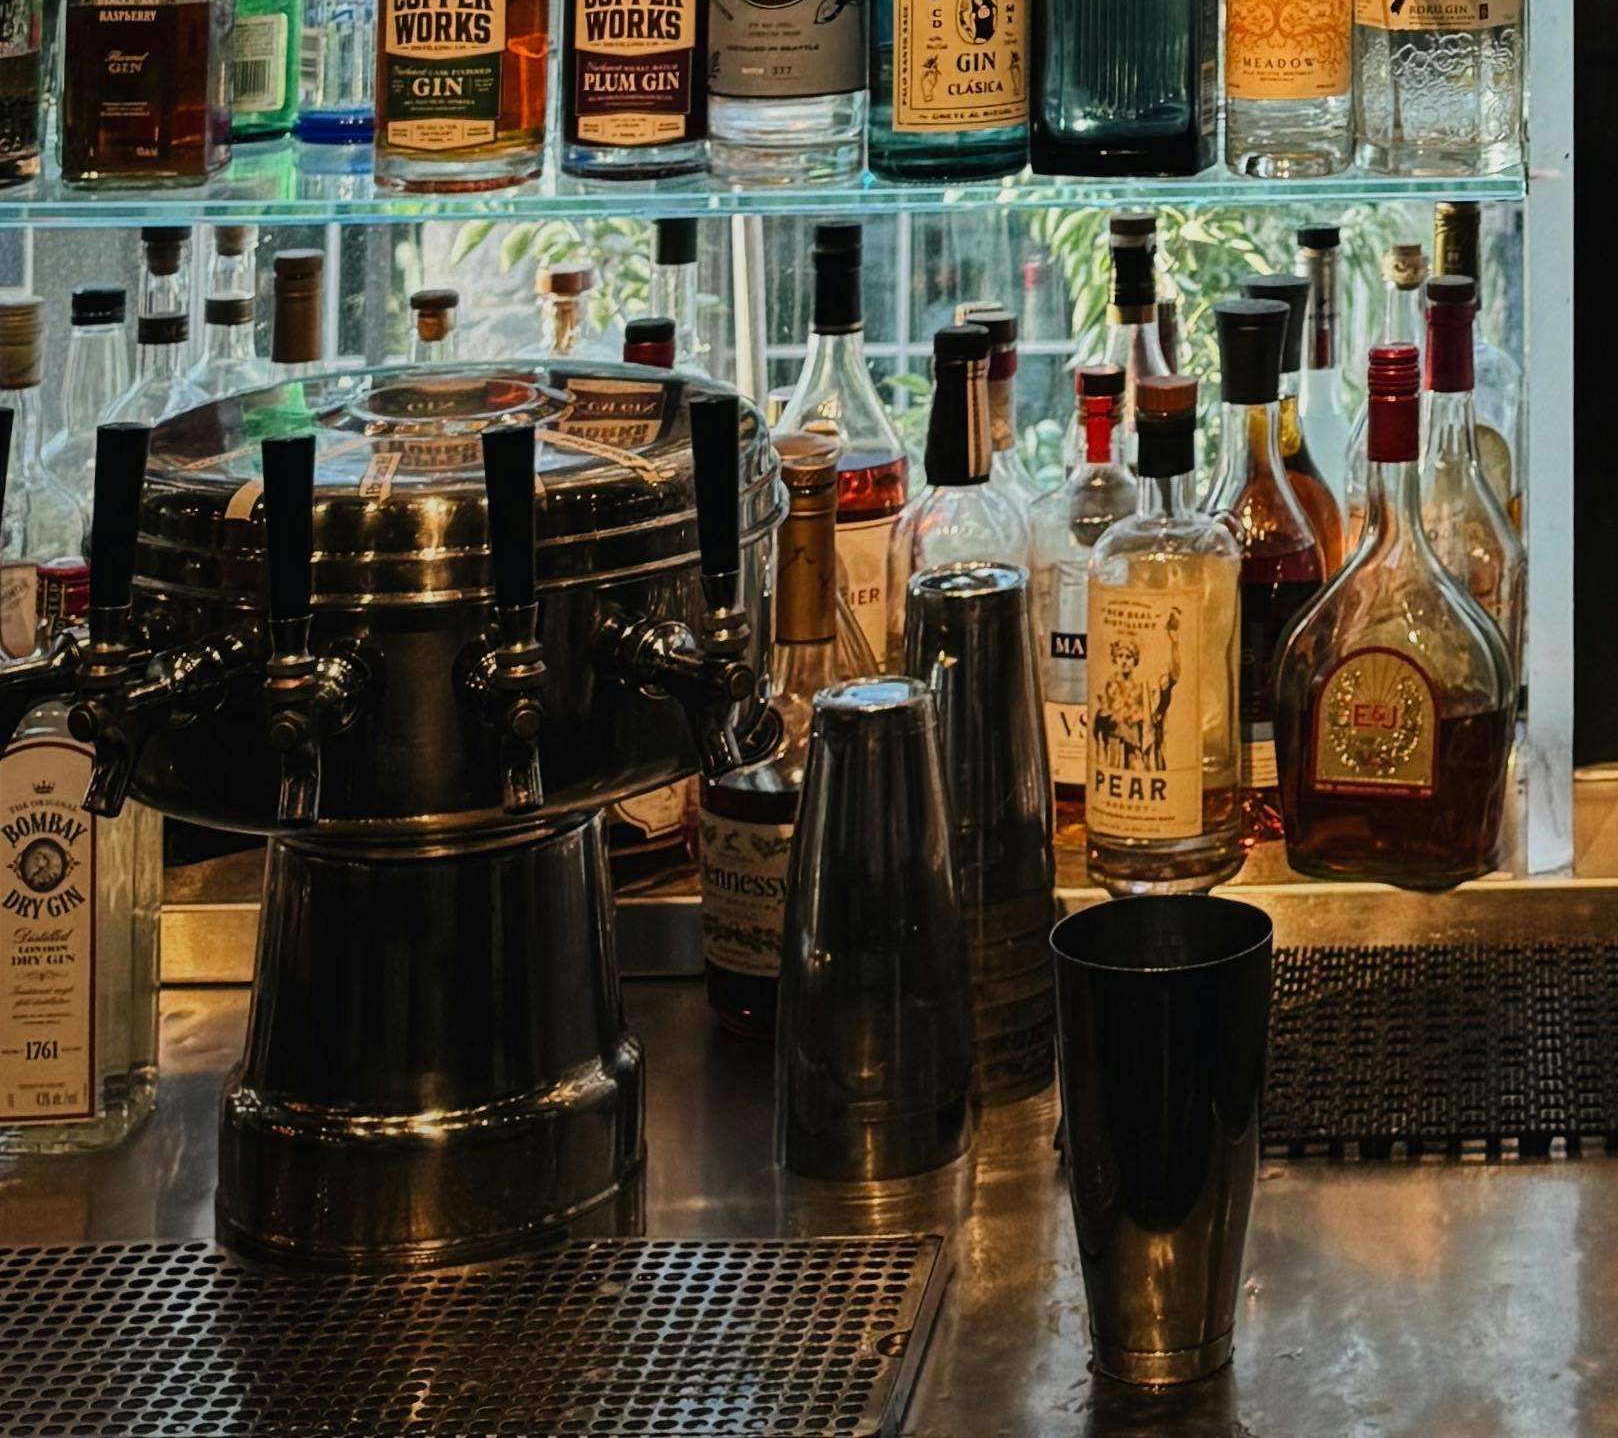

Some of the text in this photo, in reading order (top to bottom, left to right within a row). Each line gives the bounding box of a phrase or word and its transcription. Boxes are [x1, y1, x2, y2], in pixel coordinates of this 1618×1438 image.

[99, 9, 156, 22] RASPBERRY
[1409, 4, 1468, 15] ROKU GIN
[394, 13, 491, 45] WORKS
[586, 10, 681, 41] WORKS
[956, 52, 997, 73] GIN
[1243, 57, 1318, 69] MEADOW
[412, 76, 465, 98] GIN
[583, 71, 680, 94] PLUM GIN
[948, 79, 1003, 96] CLÁSICA
[1353, 703, 1399, 730] E&J
[1095, 769, 1167, 802] PEAR
[2, 812, 87, 848] BOMBAY
[703, 853, 787, 897] ennessy
[1, 885, 86, 920] DRY GIN
[11, 954, 76, 966] DRY GIN
[18, 945, 69, 954] LONDON
[25, 1040, 59, 1060] 1761
